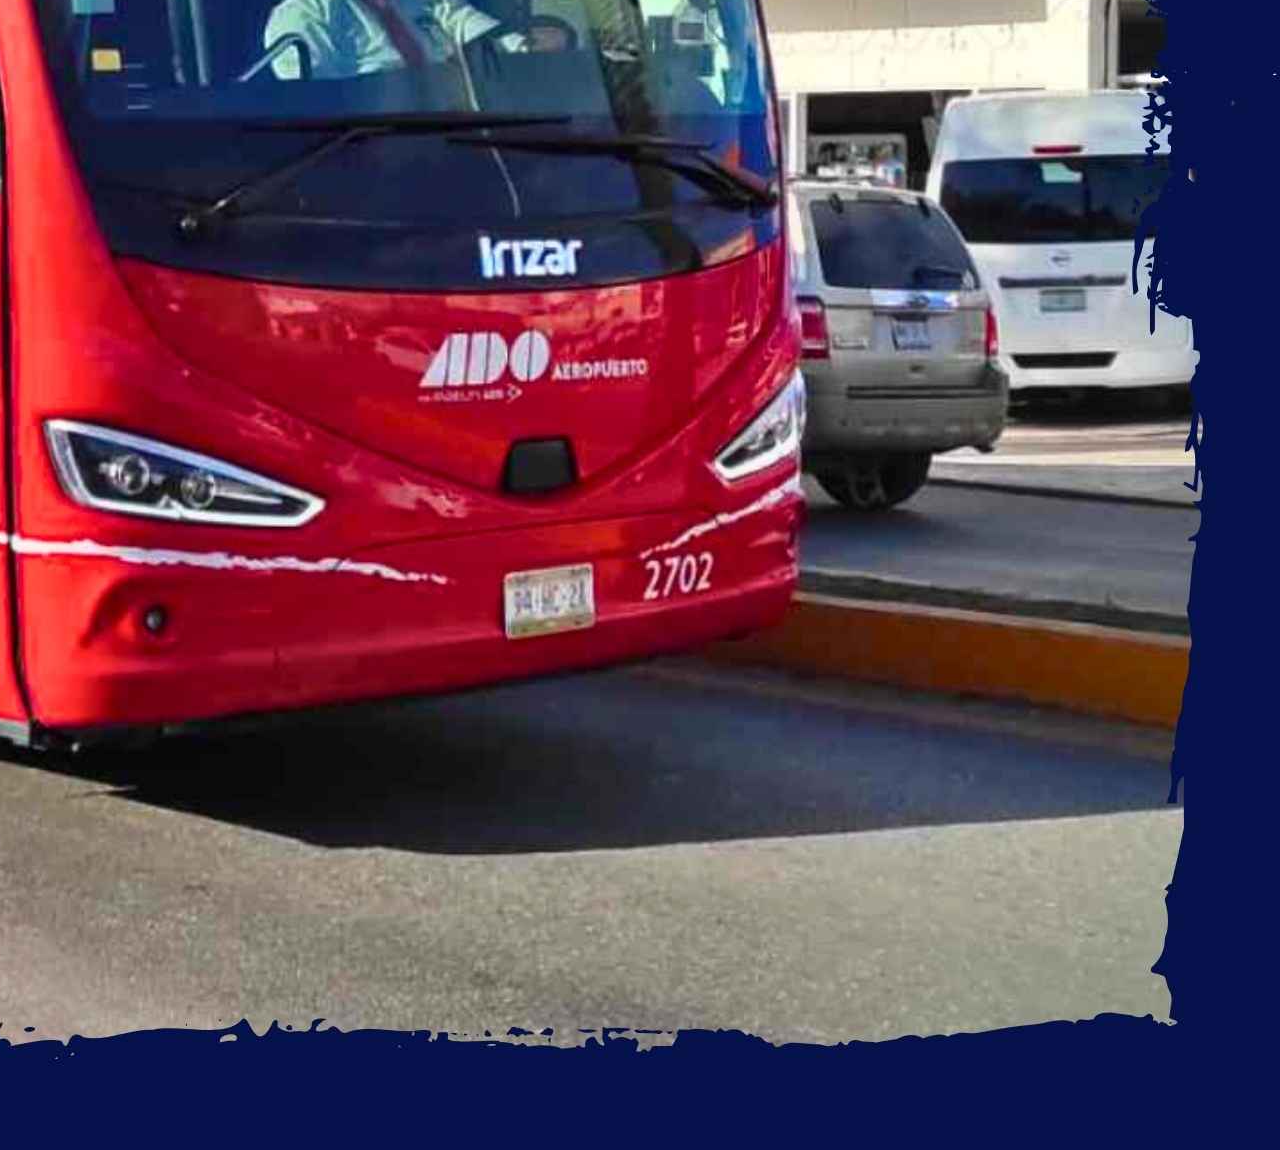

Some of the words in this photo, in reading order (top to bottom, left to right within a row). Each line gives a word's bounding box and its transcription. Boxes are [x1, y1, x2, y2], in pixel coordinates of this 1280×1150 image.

[419, 330, 551, 388] ADO
[551, 359, 648, 381] AEROPUERTO
[643, 552, 713, 600] 2702
